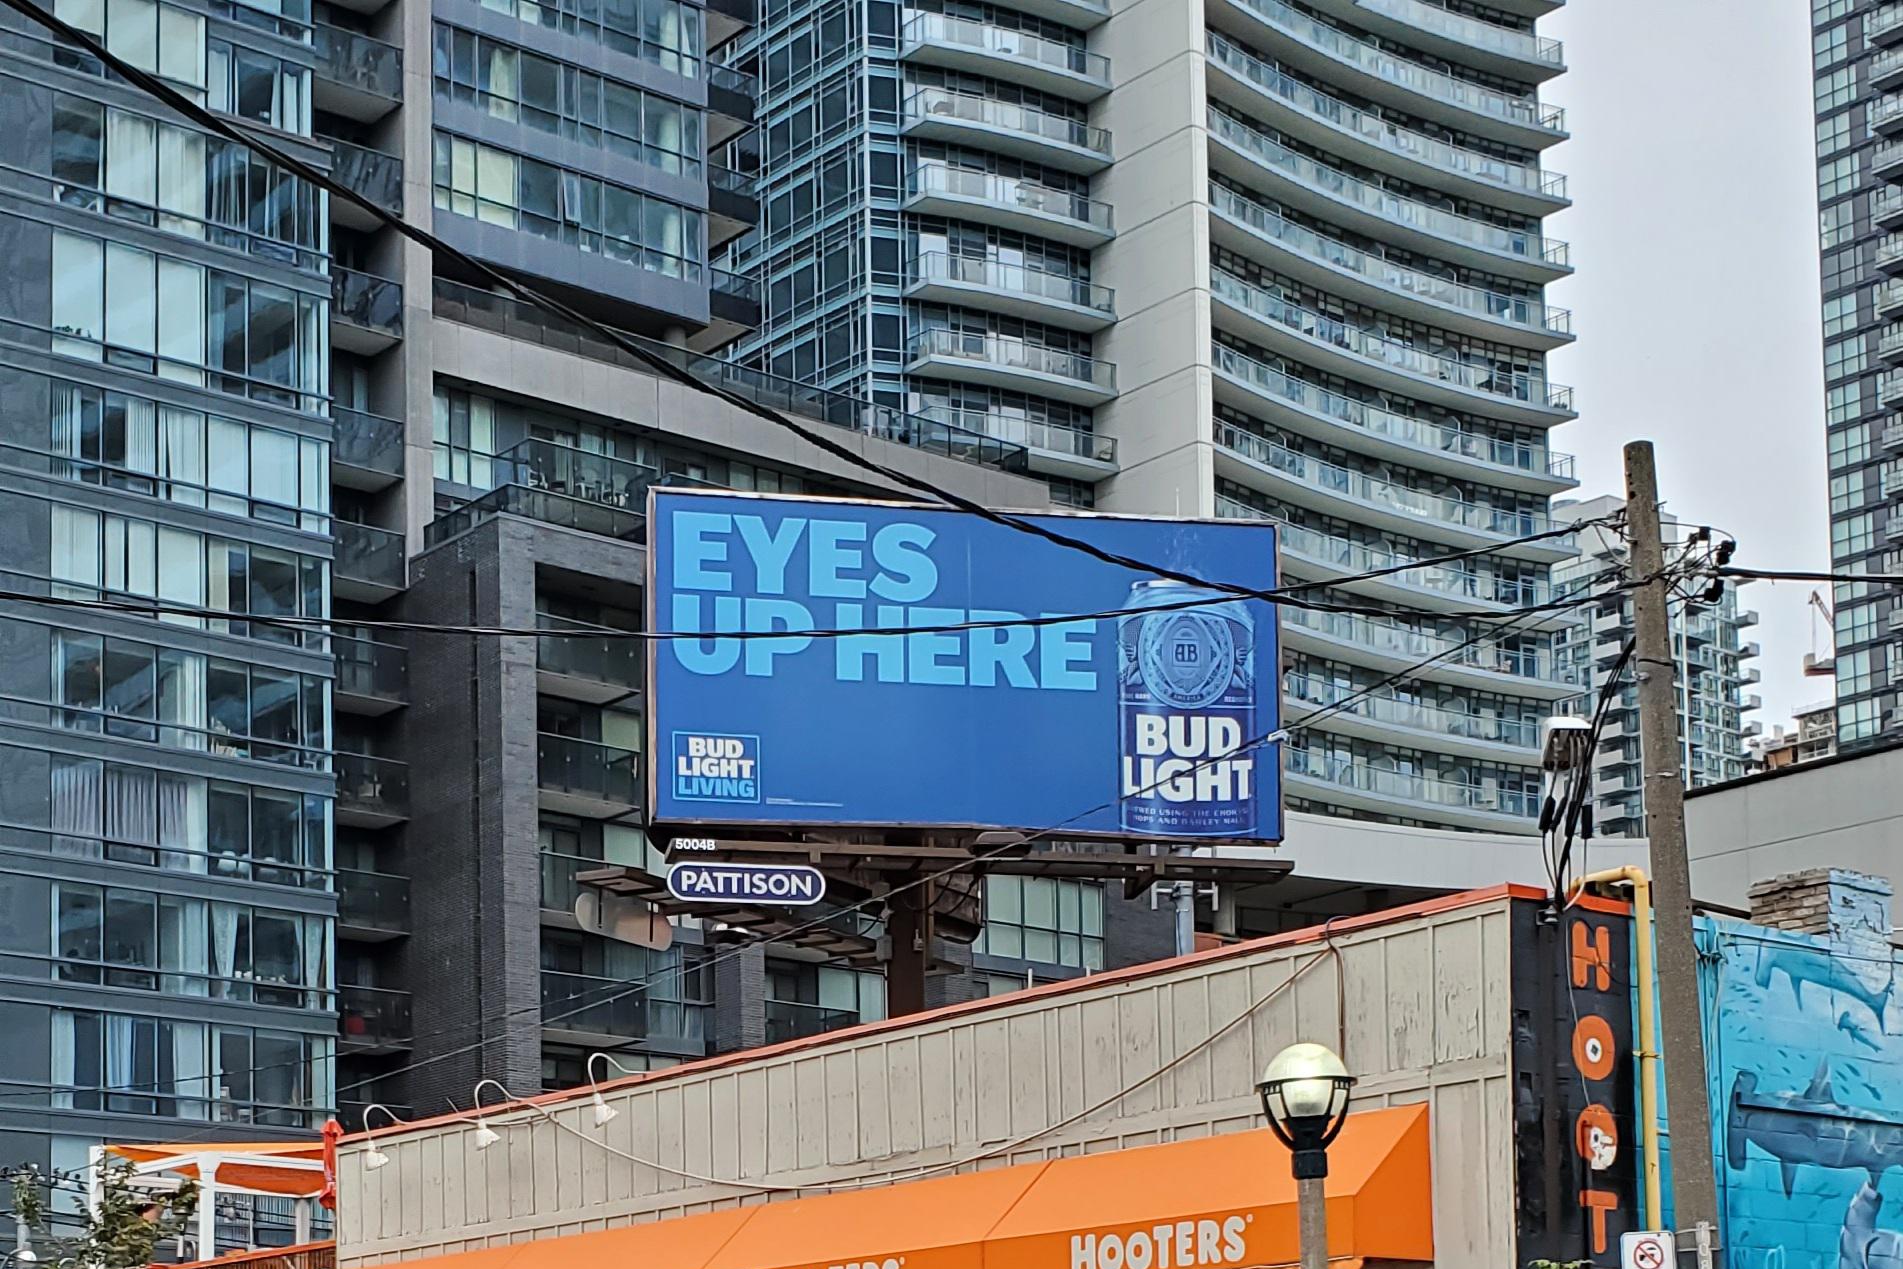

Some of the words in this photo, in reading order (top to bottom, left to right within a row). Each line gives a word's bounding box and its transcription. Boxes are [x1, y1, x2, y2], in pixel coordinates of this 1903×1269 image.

[672, 510, 938, 603] EYES
[673, 595, 813, 678] UP
[835, 603, 1097, 691] HERE
[688, 736, 744, 759] BUD
[1136, 714, 1241, 757] BUD
[678, 756, 755, 779] LIGHT
[1123, 756, 1253, 802] LIGHT
[678, 777, 755, 798] LIVING
[675, 838, 716, 851] 5004B
[681, 870, 812, 897] PATTISON
